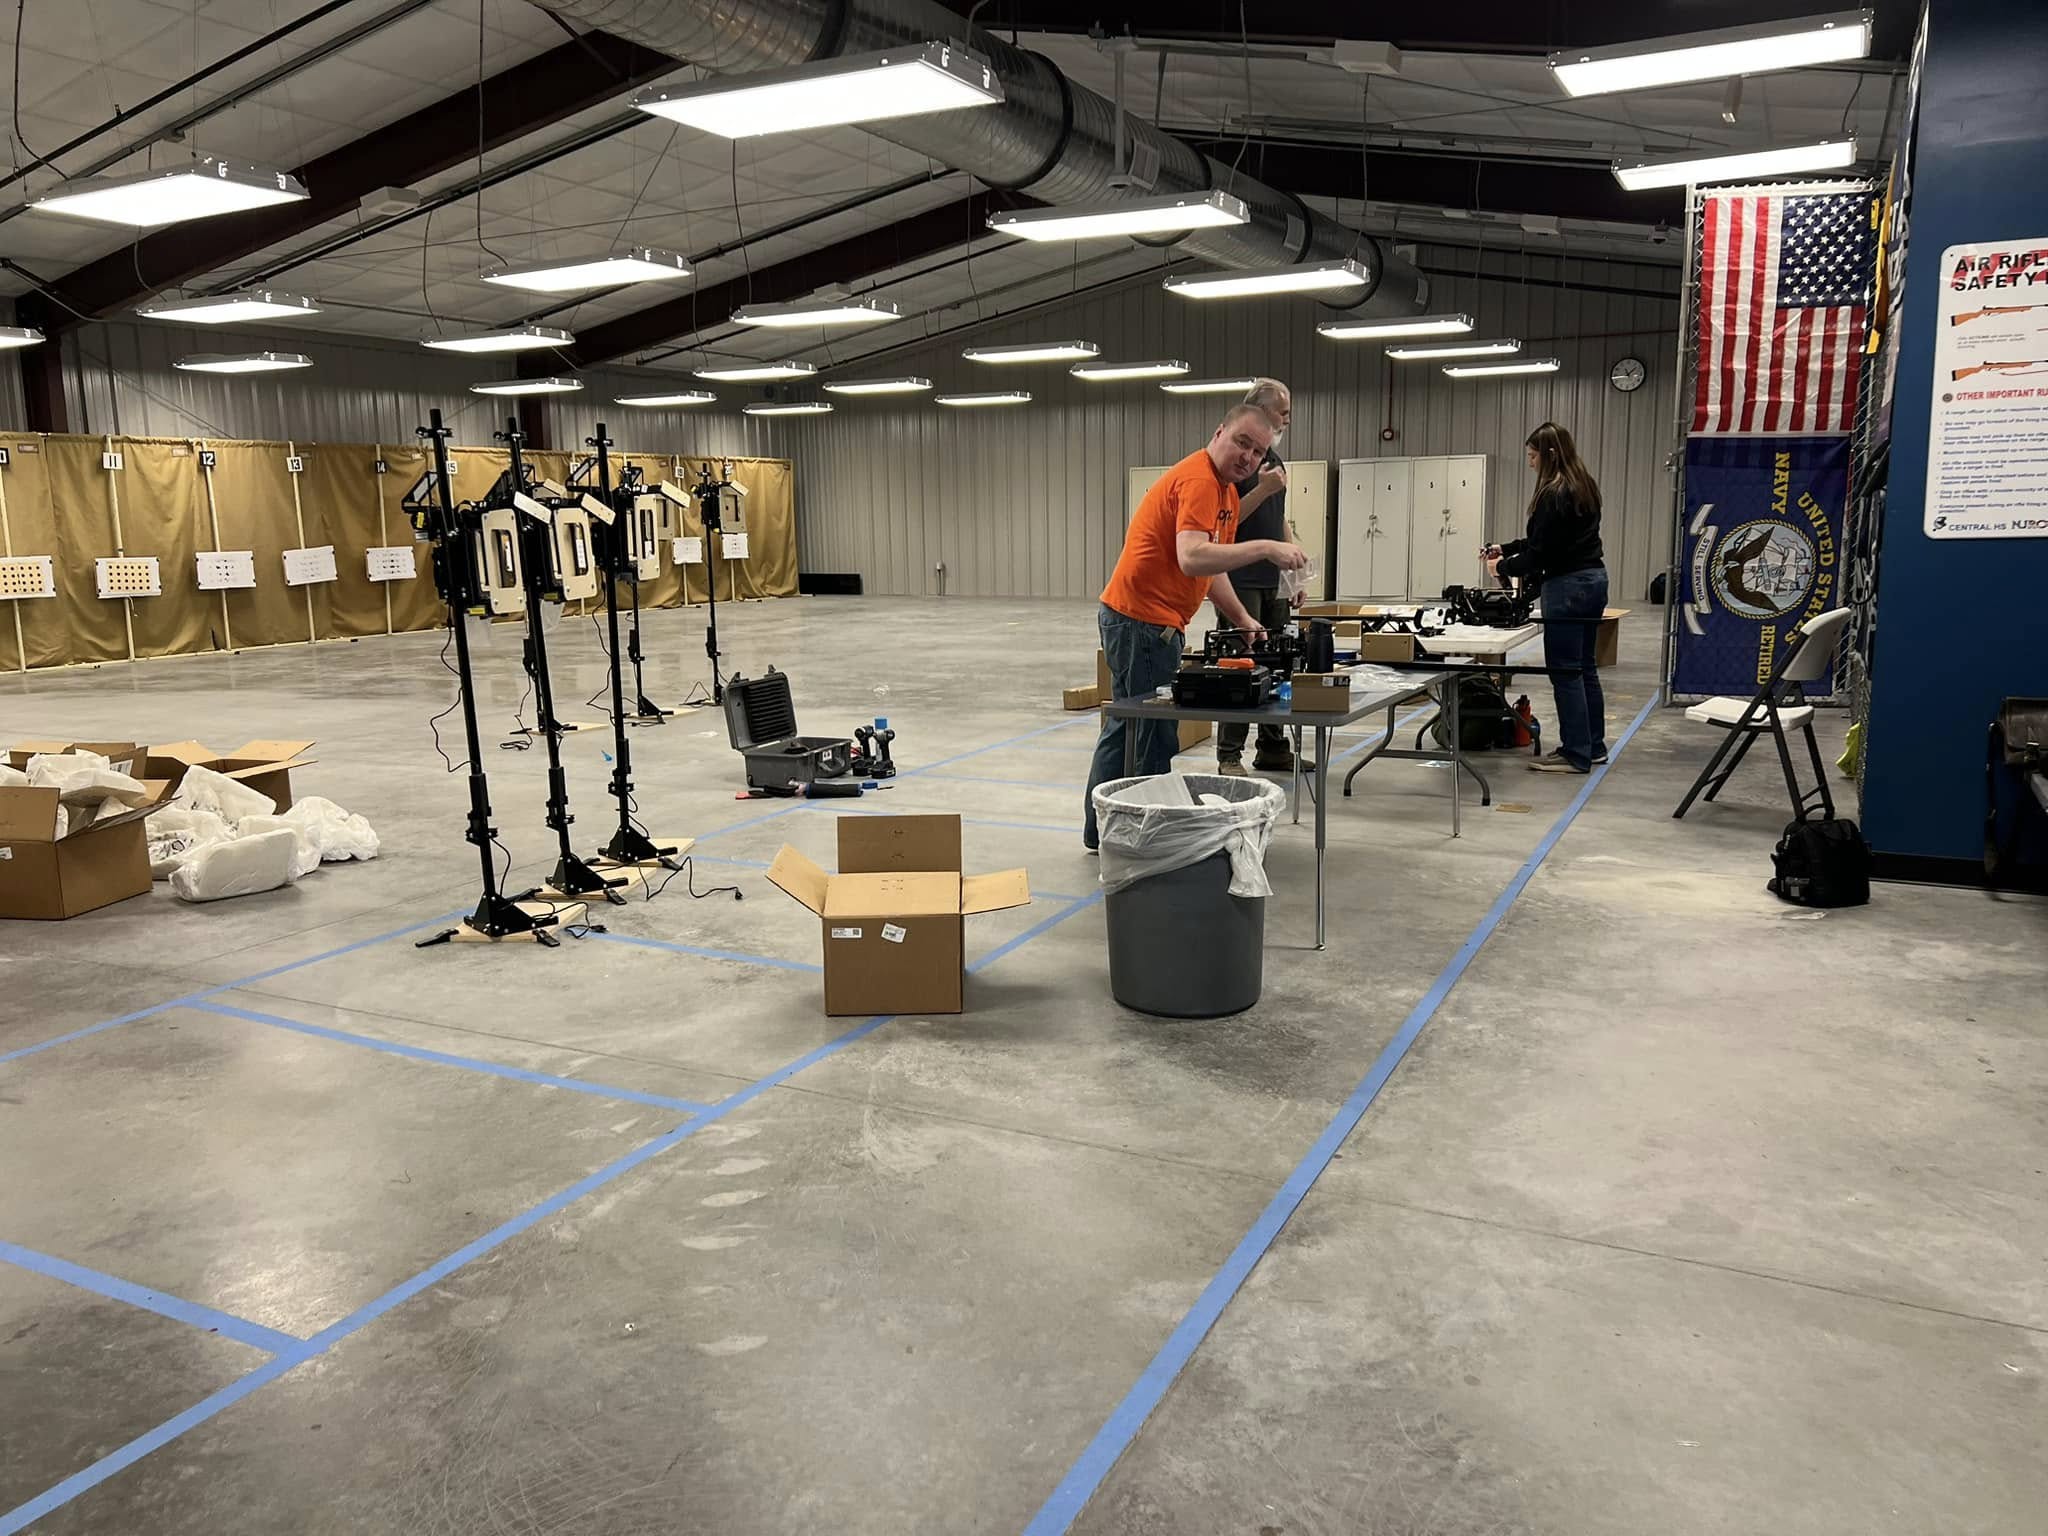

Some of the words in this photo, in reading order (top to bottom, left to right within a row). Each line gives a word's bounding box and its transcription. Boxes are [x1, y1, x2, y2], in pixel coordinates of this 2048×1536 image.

[1955, 256, 1990, 273] AIR
[1999, 252, 2048, 269] RIFL
[1954, 271, 2037, 292] SAFETY
[1957, 391, 1984, 401] OTHER
[1986, 389, 2034, 400] IMPORTANT
[109, 455, 118, 468] 11
[202, 453, 214, 466] 12
[290, 458, 301, 470] 13
[376, 462, 386, 473] 14
[447, 462, 456, 473] 15
[1771, 452, 1791, 514] NAVY
[1797, 491, 1835, 566] UNITED
[1949, 524, 1992, 532] CENTRAL
[1993, 523, 2007, 531] HS
[1696, 537, 1710, 560] STILL
[1694, 565, 1705, 601] SERVING
[1757, 625, 1776, 685] RETIRED
